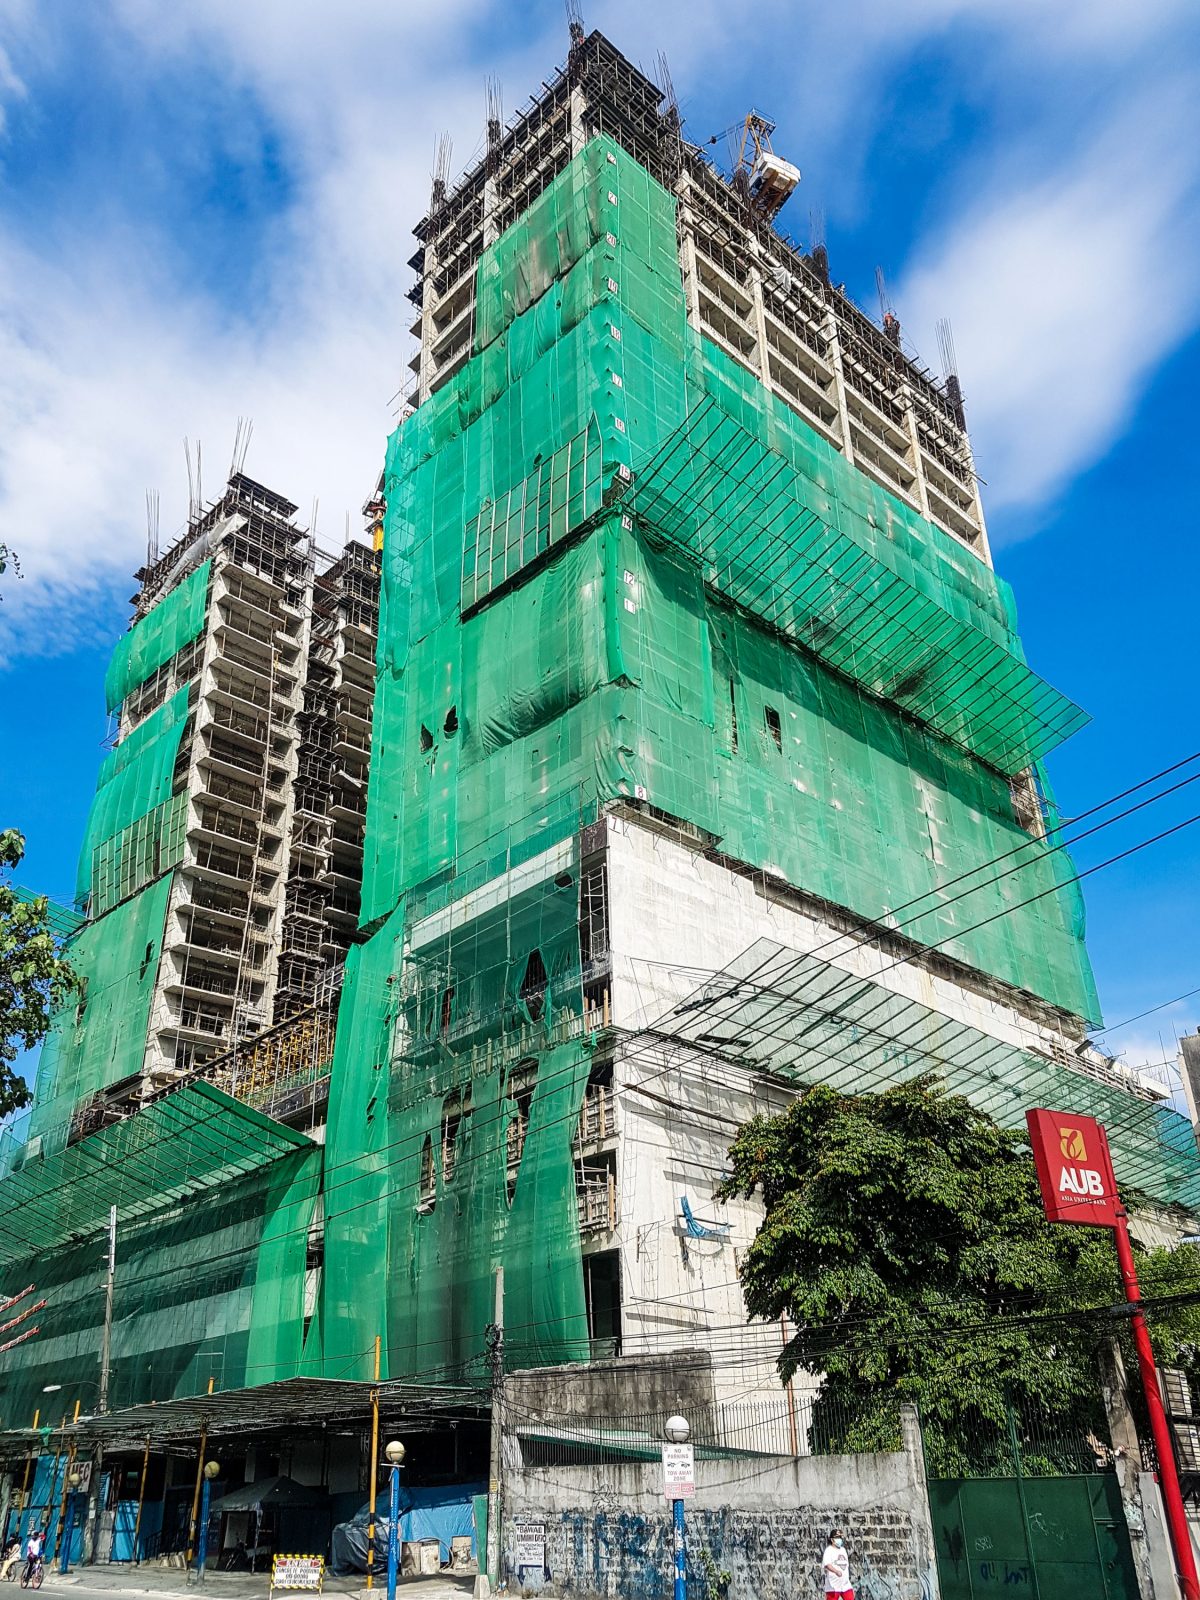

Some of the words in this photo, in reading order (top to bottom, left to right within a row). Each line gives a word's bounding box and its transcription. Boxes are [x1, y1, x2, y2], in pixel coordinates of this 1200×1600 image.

[621, 465, 630, 479] 15
[623, 516, 631, 530] 14
[1059, 1166, 1104, 1196] AUB
